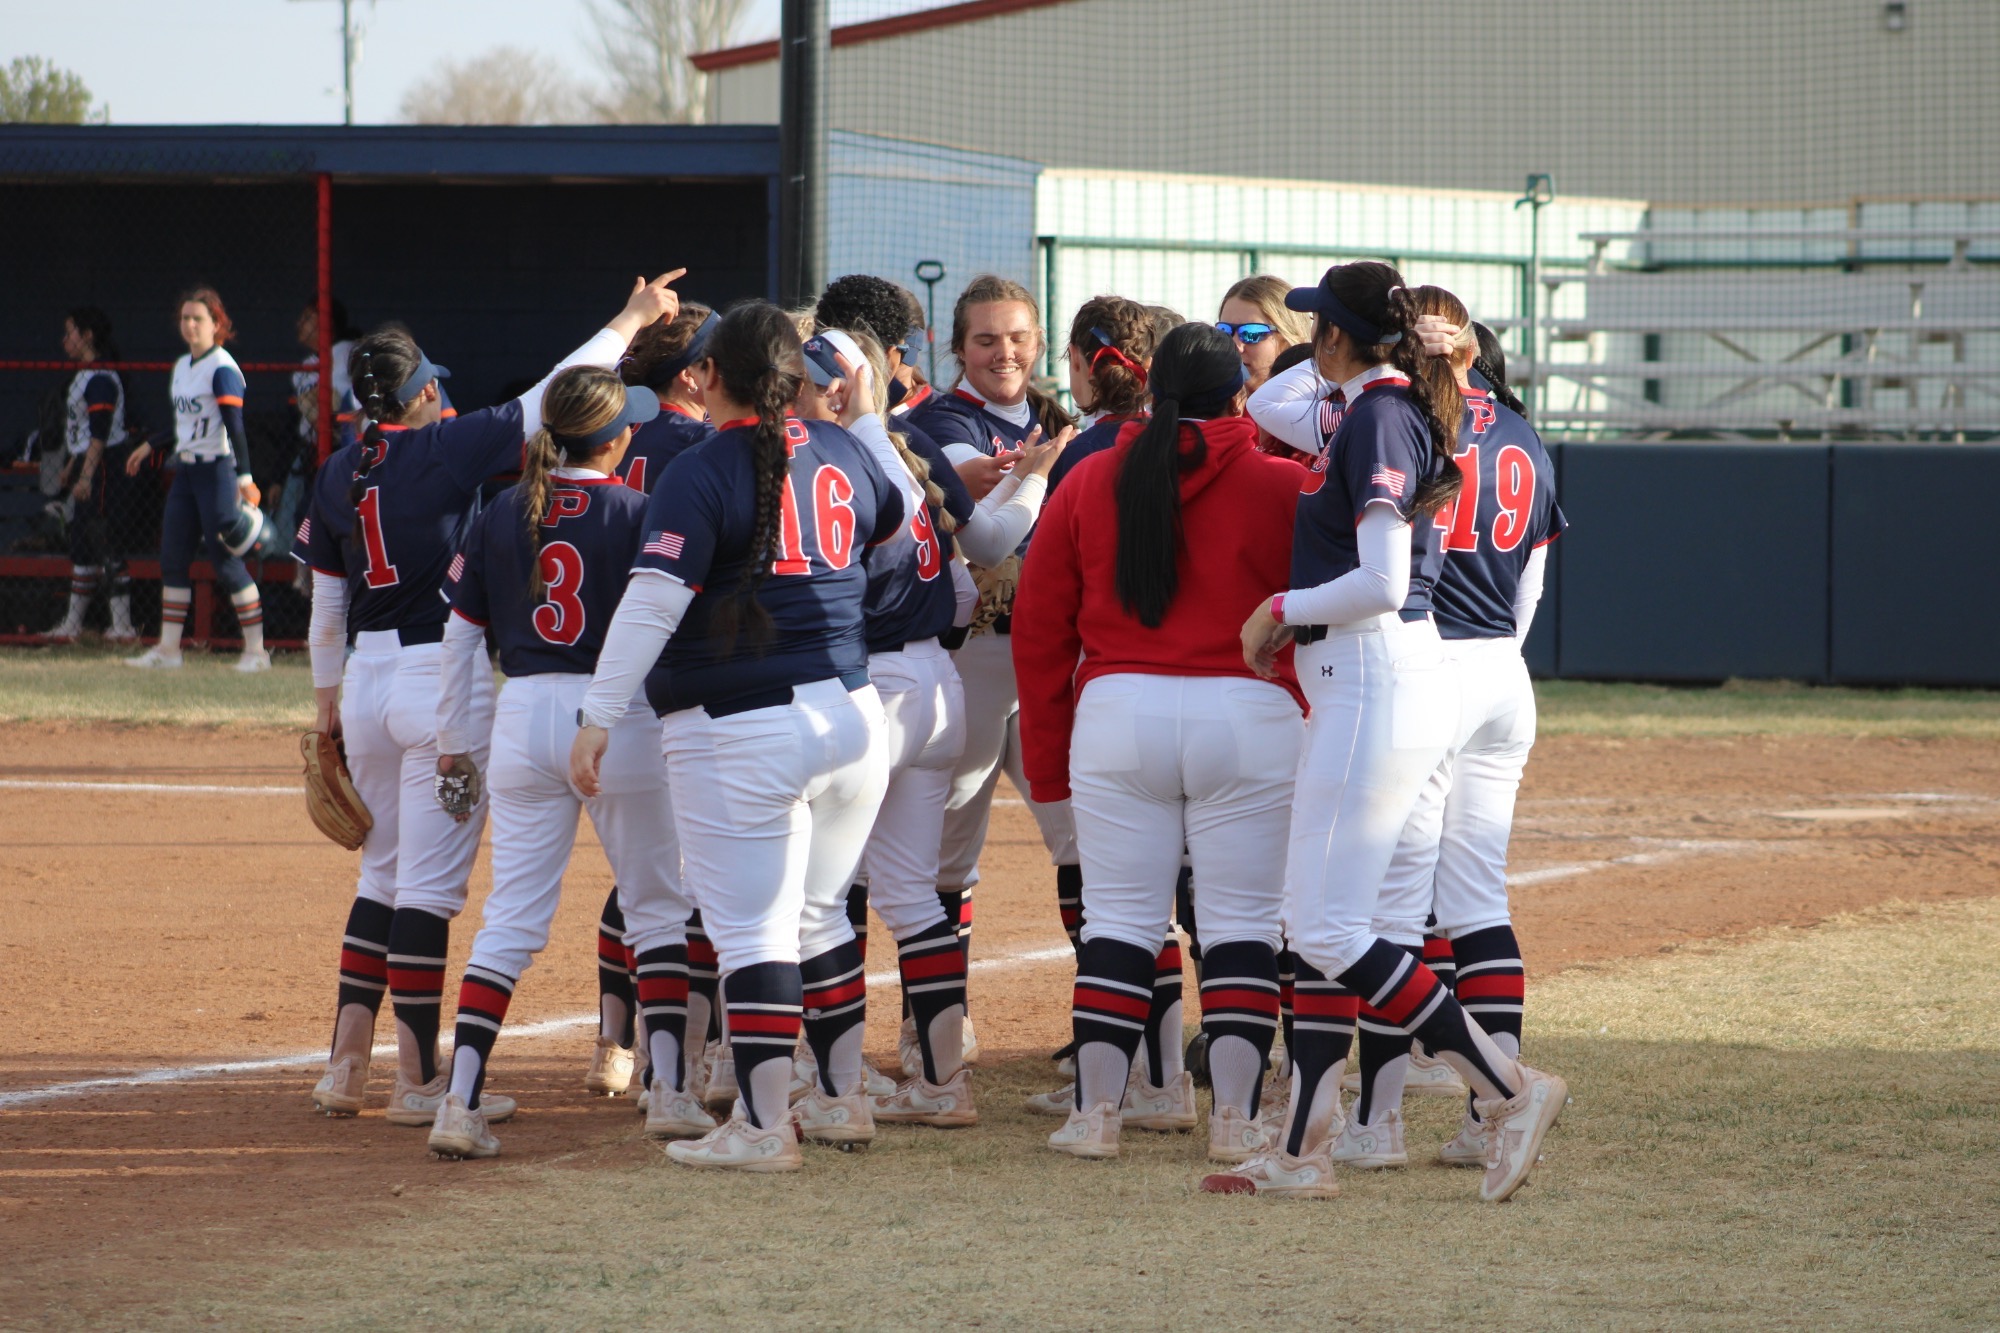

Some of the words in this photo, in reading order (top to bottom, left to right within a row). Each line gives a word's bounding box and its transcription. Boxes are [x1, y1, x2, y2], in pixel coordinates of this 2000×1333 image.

[1466, 398, 1496, 434] P
[358, 485, 400, 589] 1
[541, 489, 592, 528] P
[772, 463, 856, 575] 16
[1448, 443, 1536, 552] 19
[532, 541, 586, 647] 3
